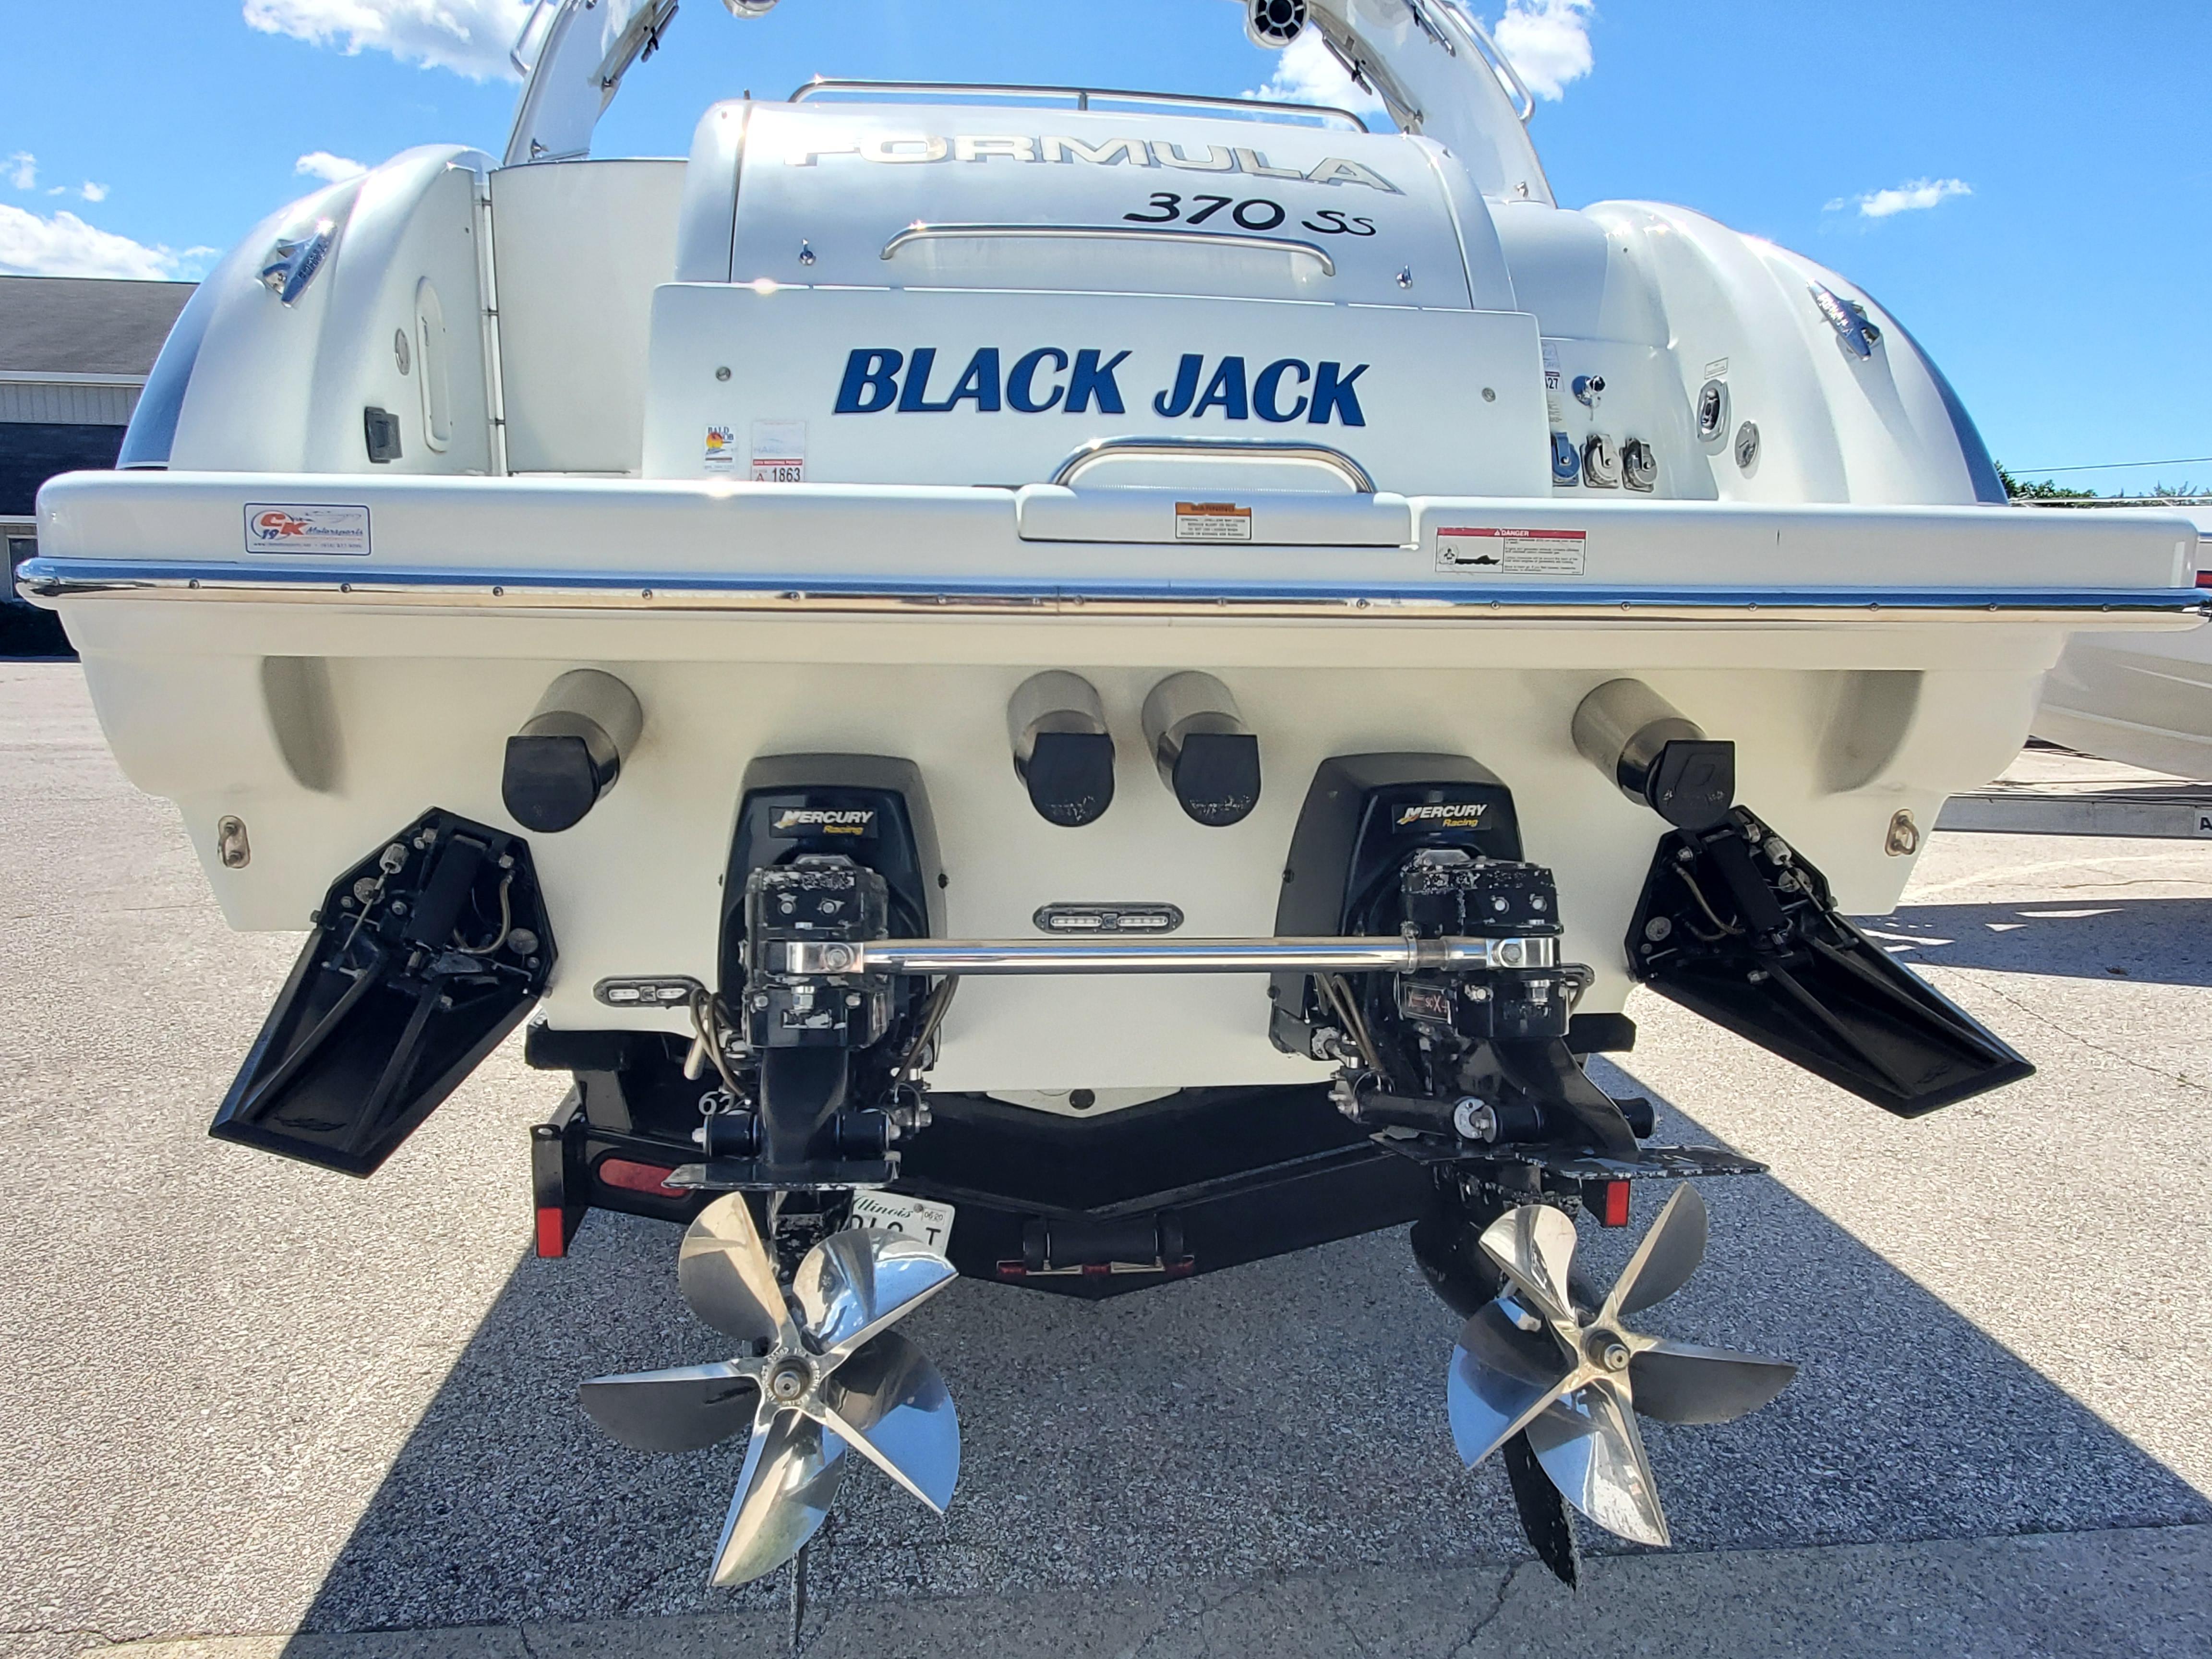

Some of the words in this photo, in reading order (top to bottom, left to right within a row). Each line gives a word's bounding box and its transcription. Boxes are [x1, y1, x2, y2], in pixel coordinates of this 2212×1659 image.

[784, 133, 1401, 193] FORMULA
[1123, 192, 1286, 231] 370
[832, 347, 1133, 414] BLACK
[1153, 353, 1370, 427] JACK
[772, 468, 800, 482] 1863
[781, 810, 874, 824] MERCURY
[1404, 804, 1488, 820] MERCURY
[1443, 818, 1479, 828] Racing
[926, 1227, 941, 1246] T
